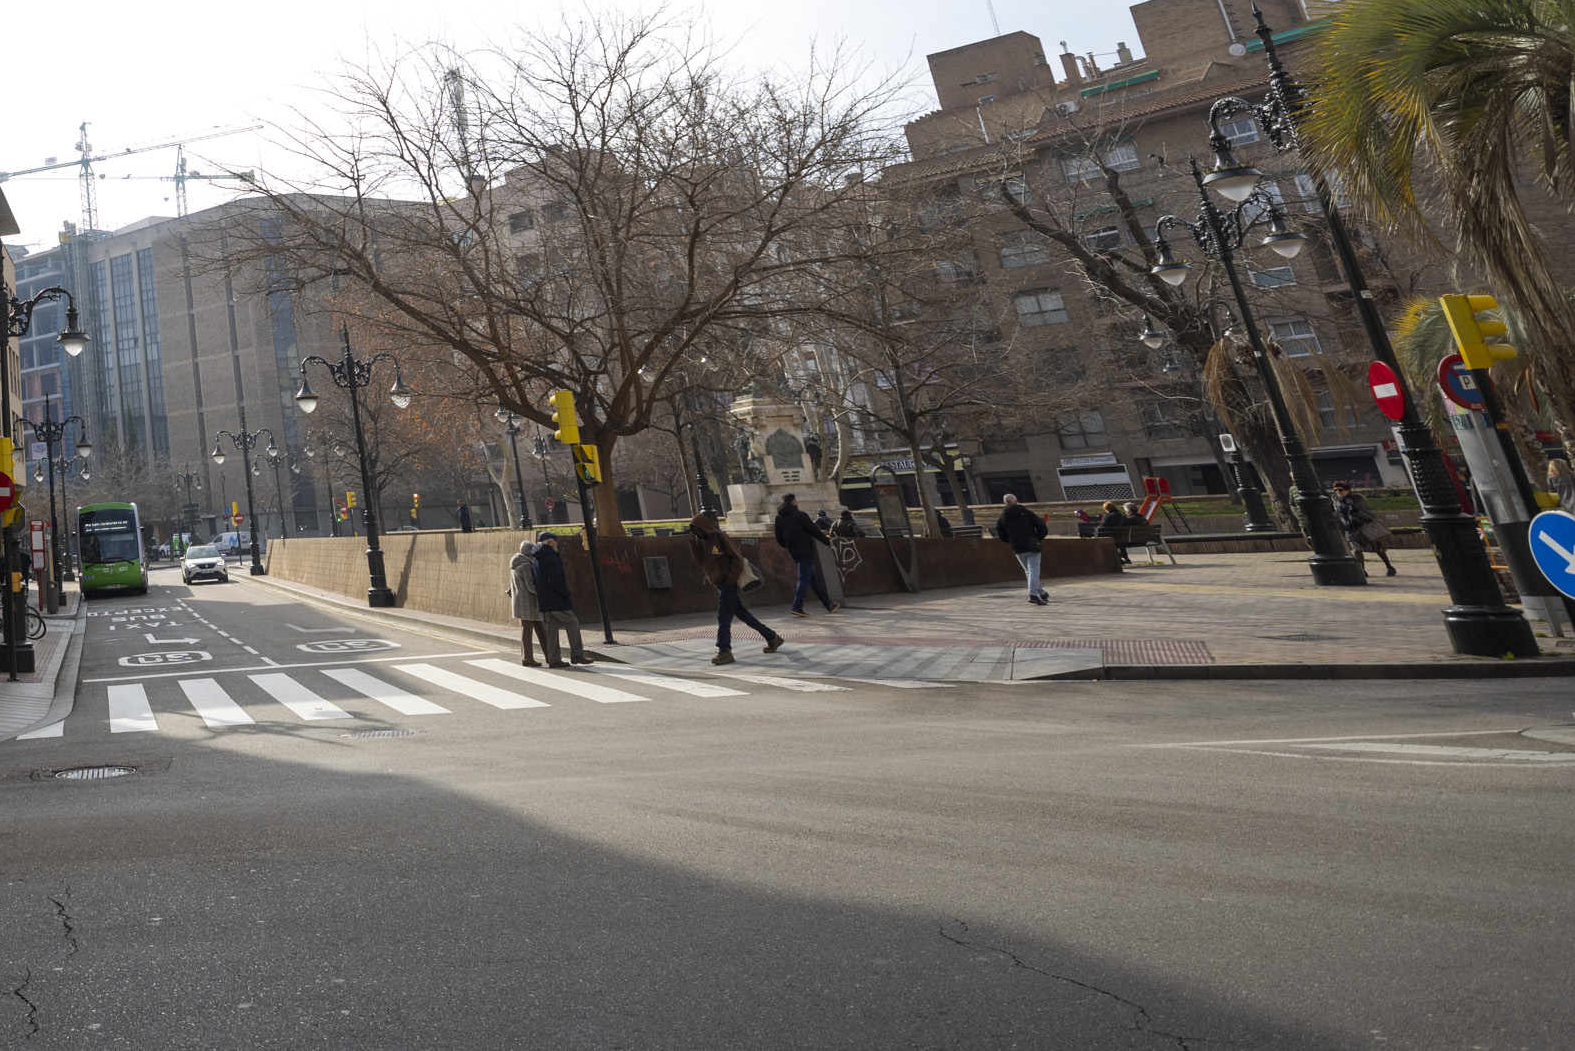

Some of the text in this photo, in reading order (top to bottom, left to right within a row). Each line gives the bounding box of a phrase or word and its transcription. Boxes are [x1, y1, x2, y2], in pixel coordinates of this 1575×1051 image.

[87, 606, 184, 617] EXCEPTO
[111, 614, 167, 623] BUS
[109, 621, 184, 631] TAXI
[138, 653, 193, 664] 30
